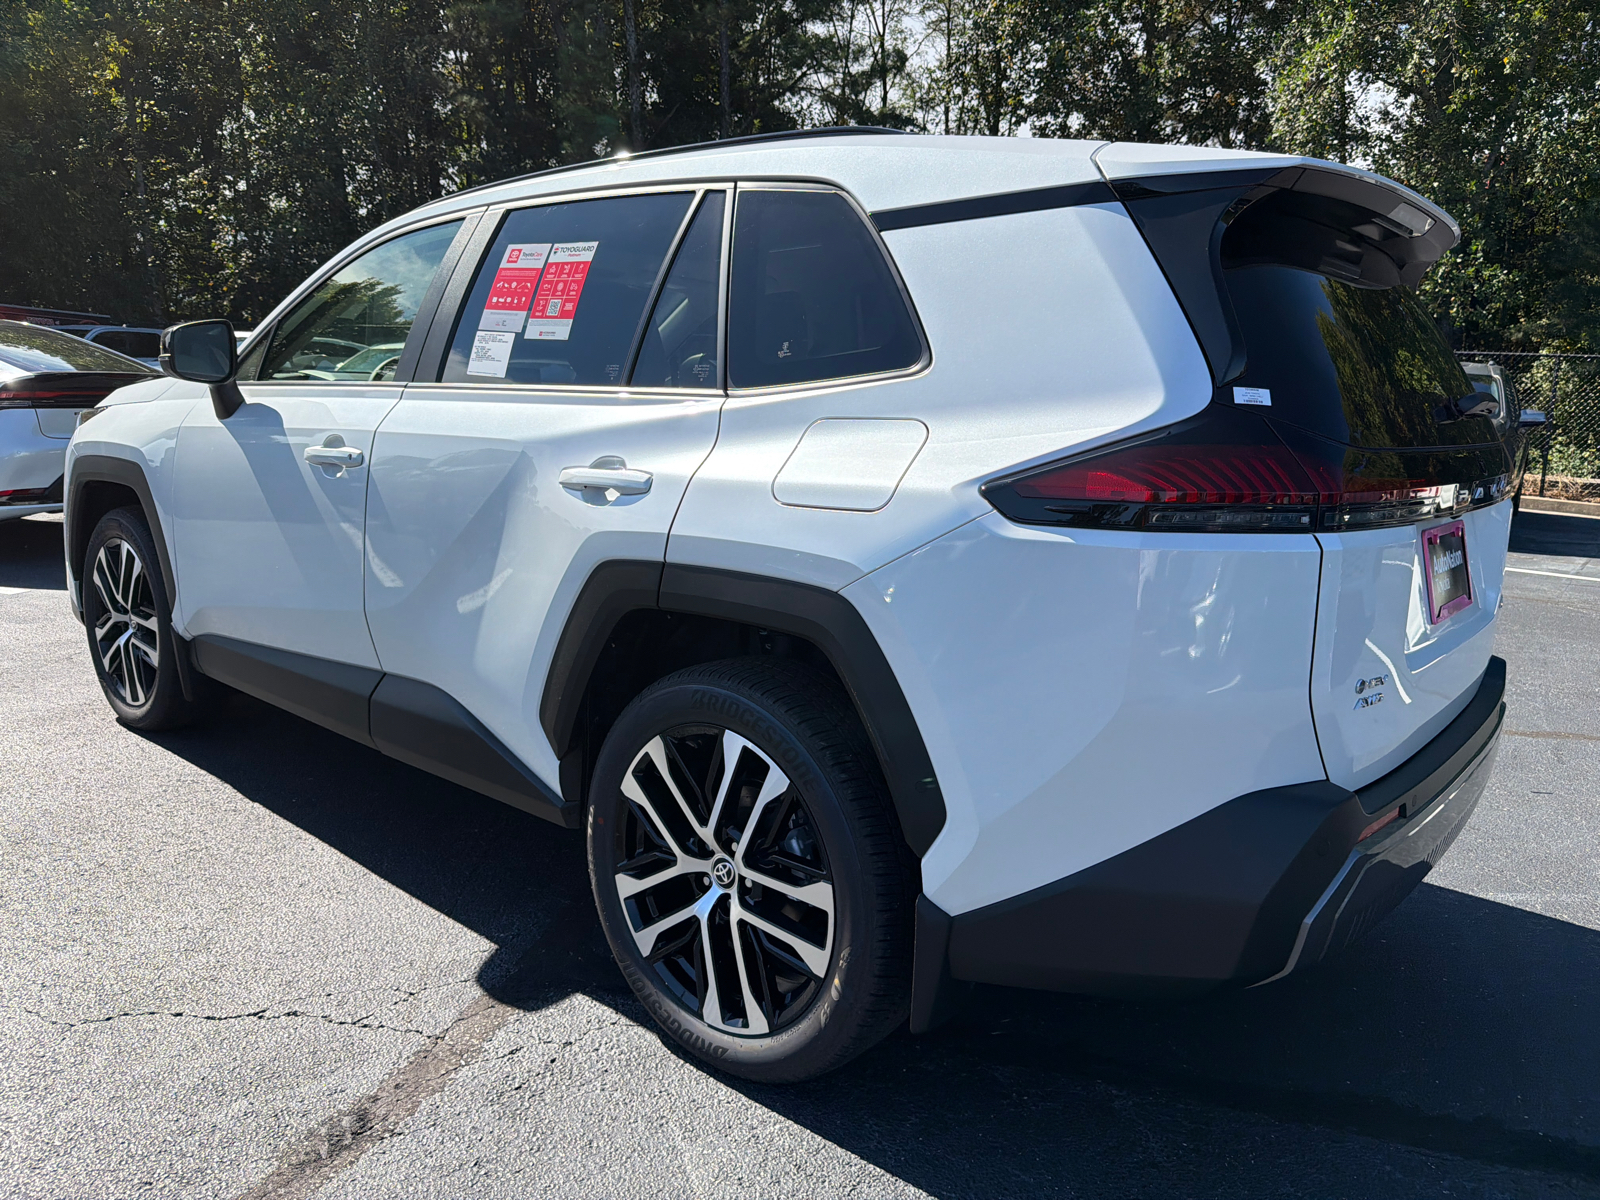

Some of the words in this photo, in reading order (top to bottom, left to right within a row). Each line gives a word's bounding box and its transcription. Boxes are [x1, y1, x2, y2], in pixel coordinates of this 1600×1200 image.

[560, 246, 595, 254] TOYOGUARD
[1433, 549, 1463, 576] AutoNation
[1435, 576, 1451, 594] Toyota
[690, 688, 816, 793] BRIDGESTONE
